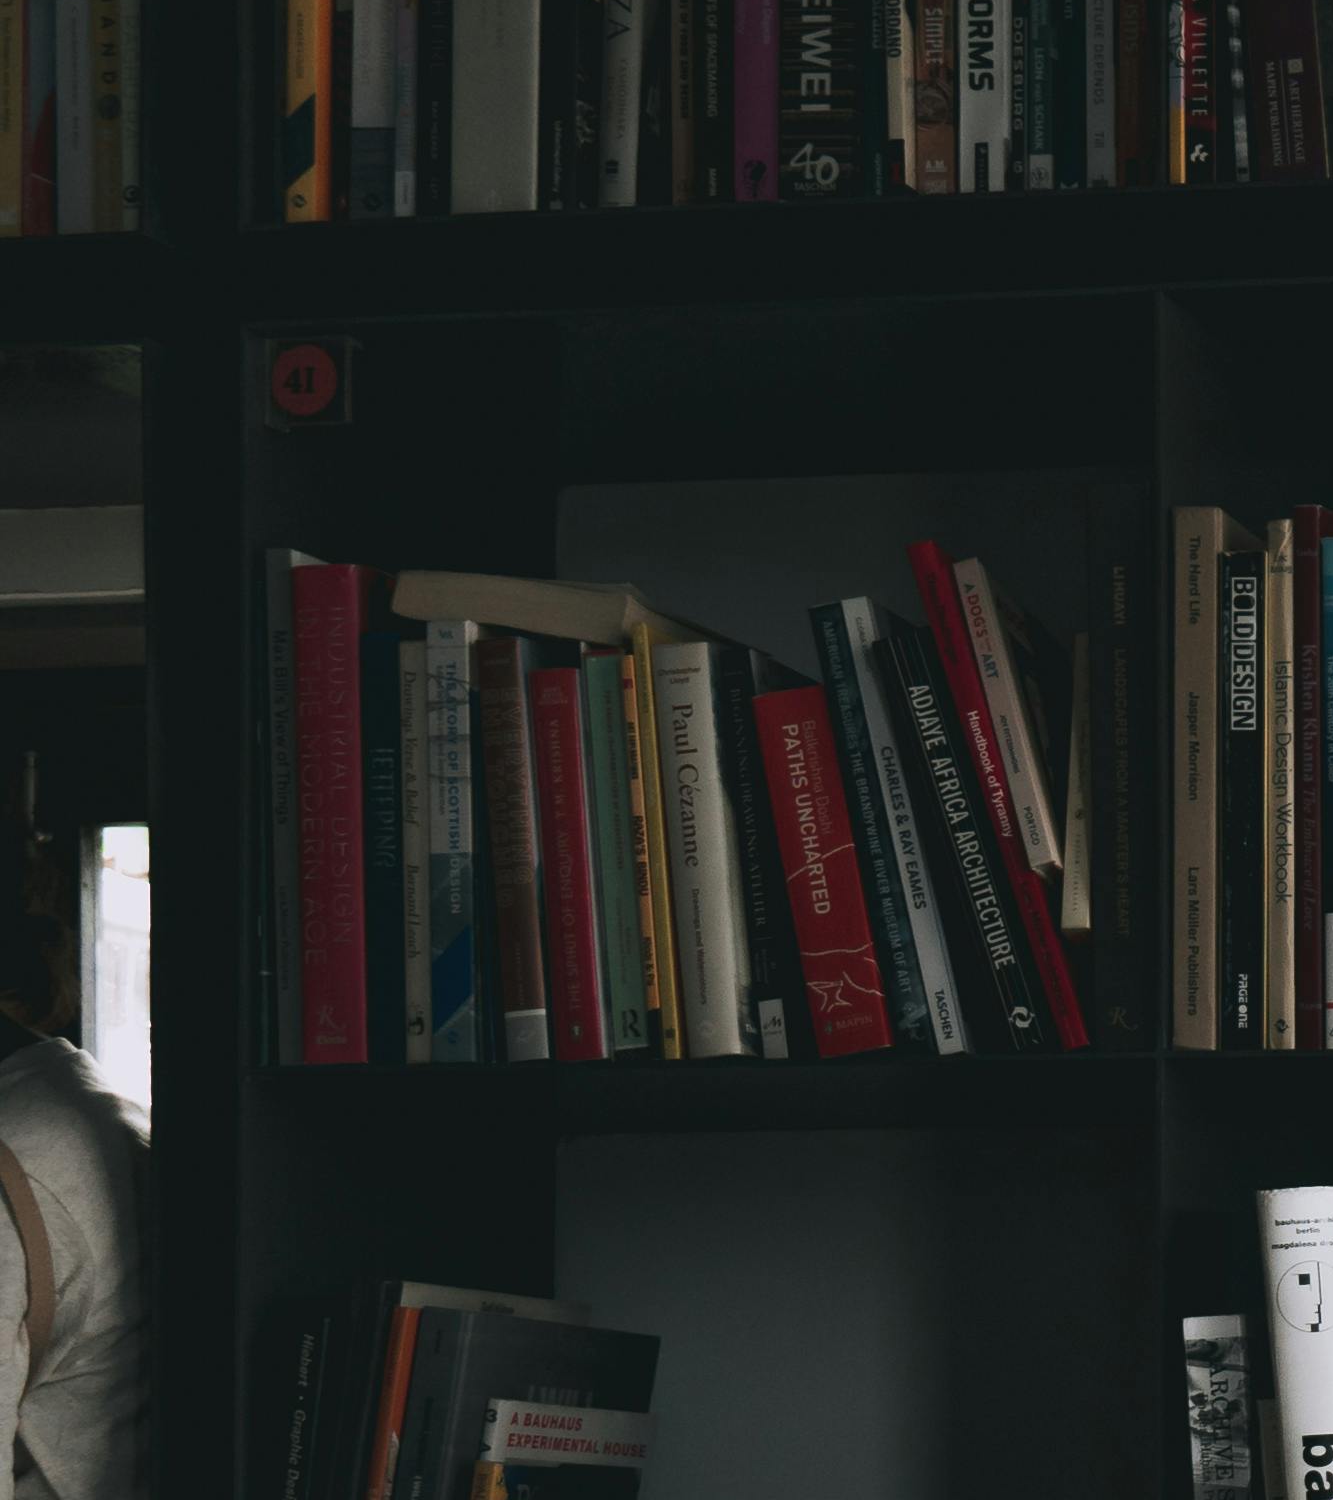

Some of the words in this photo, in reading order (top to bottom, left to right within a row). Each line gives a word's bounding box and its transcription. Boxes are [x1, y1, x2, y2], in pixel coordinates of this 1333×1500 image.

[1191, 18, 1208, 117] VILLETTE
[1189, 536, 1201, 560] The
[1189, 564, 1201, 601] Hard
[1233, 578, 1255, 640] BOLD
[1189, 603, 1201, 625] Life
[1187, 692, 1201, 737] Jasper
[1231, 644, 1255, 729] DESIGN
[782, 723, 807, 789] PATHS
[1188, 741, 1201, 801] Morrison
[794, 794, 832, 915] UNCHARTED
[908, 685, 941, 751] ADJAYE
[929, 757, 969, 824] AFRICA
[954, 831, 1015, 970] ARCHITECTURE
